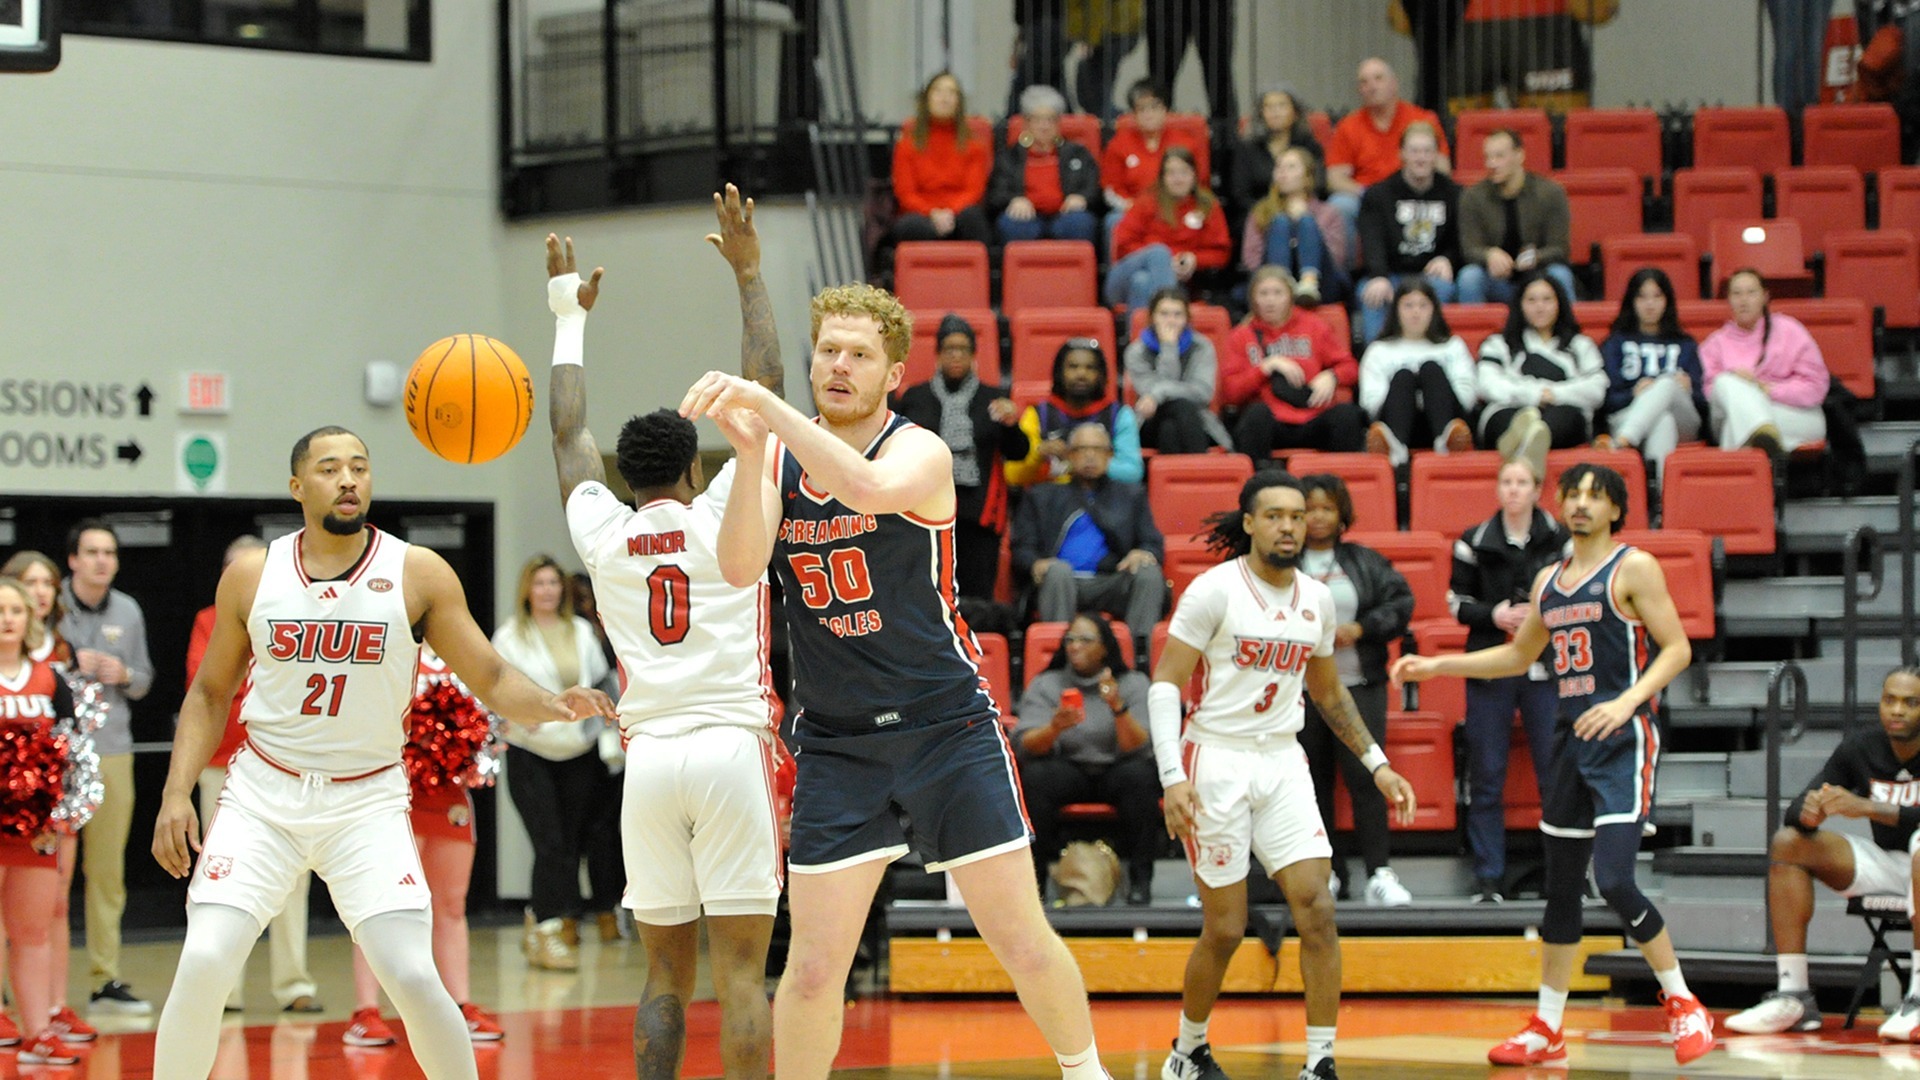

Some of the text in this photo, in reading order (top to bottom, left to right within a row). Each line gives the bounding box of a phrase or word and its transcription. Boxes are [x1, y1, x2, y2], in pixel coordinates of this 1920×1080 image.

[627, 530, 687, 557] MINOR
[779, 513, 878, 545] SREAMING
[788, 546, 873, 609] 50
[646, 564, 691, 646] 0
[267, 619, 388, 664] SIUE
[1552, 626, 1593, 675] 33
[301, 673, 347, 716] 21
[1254, 682, 1278, 713] 3
[1869, 777, 1920, 808] SIU
